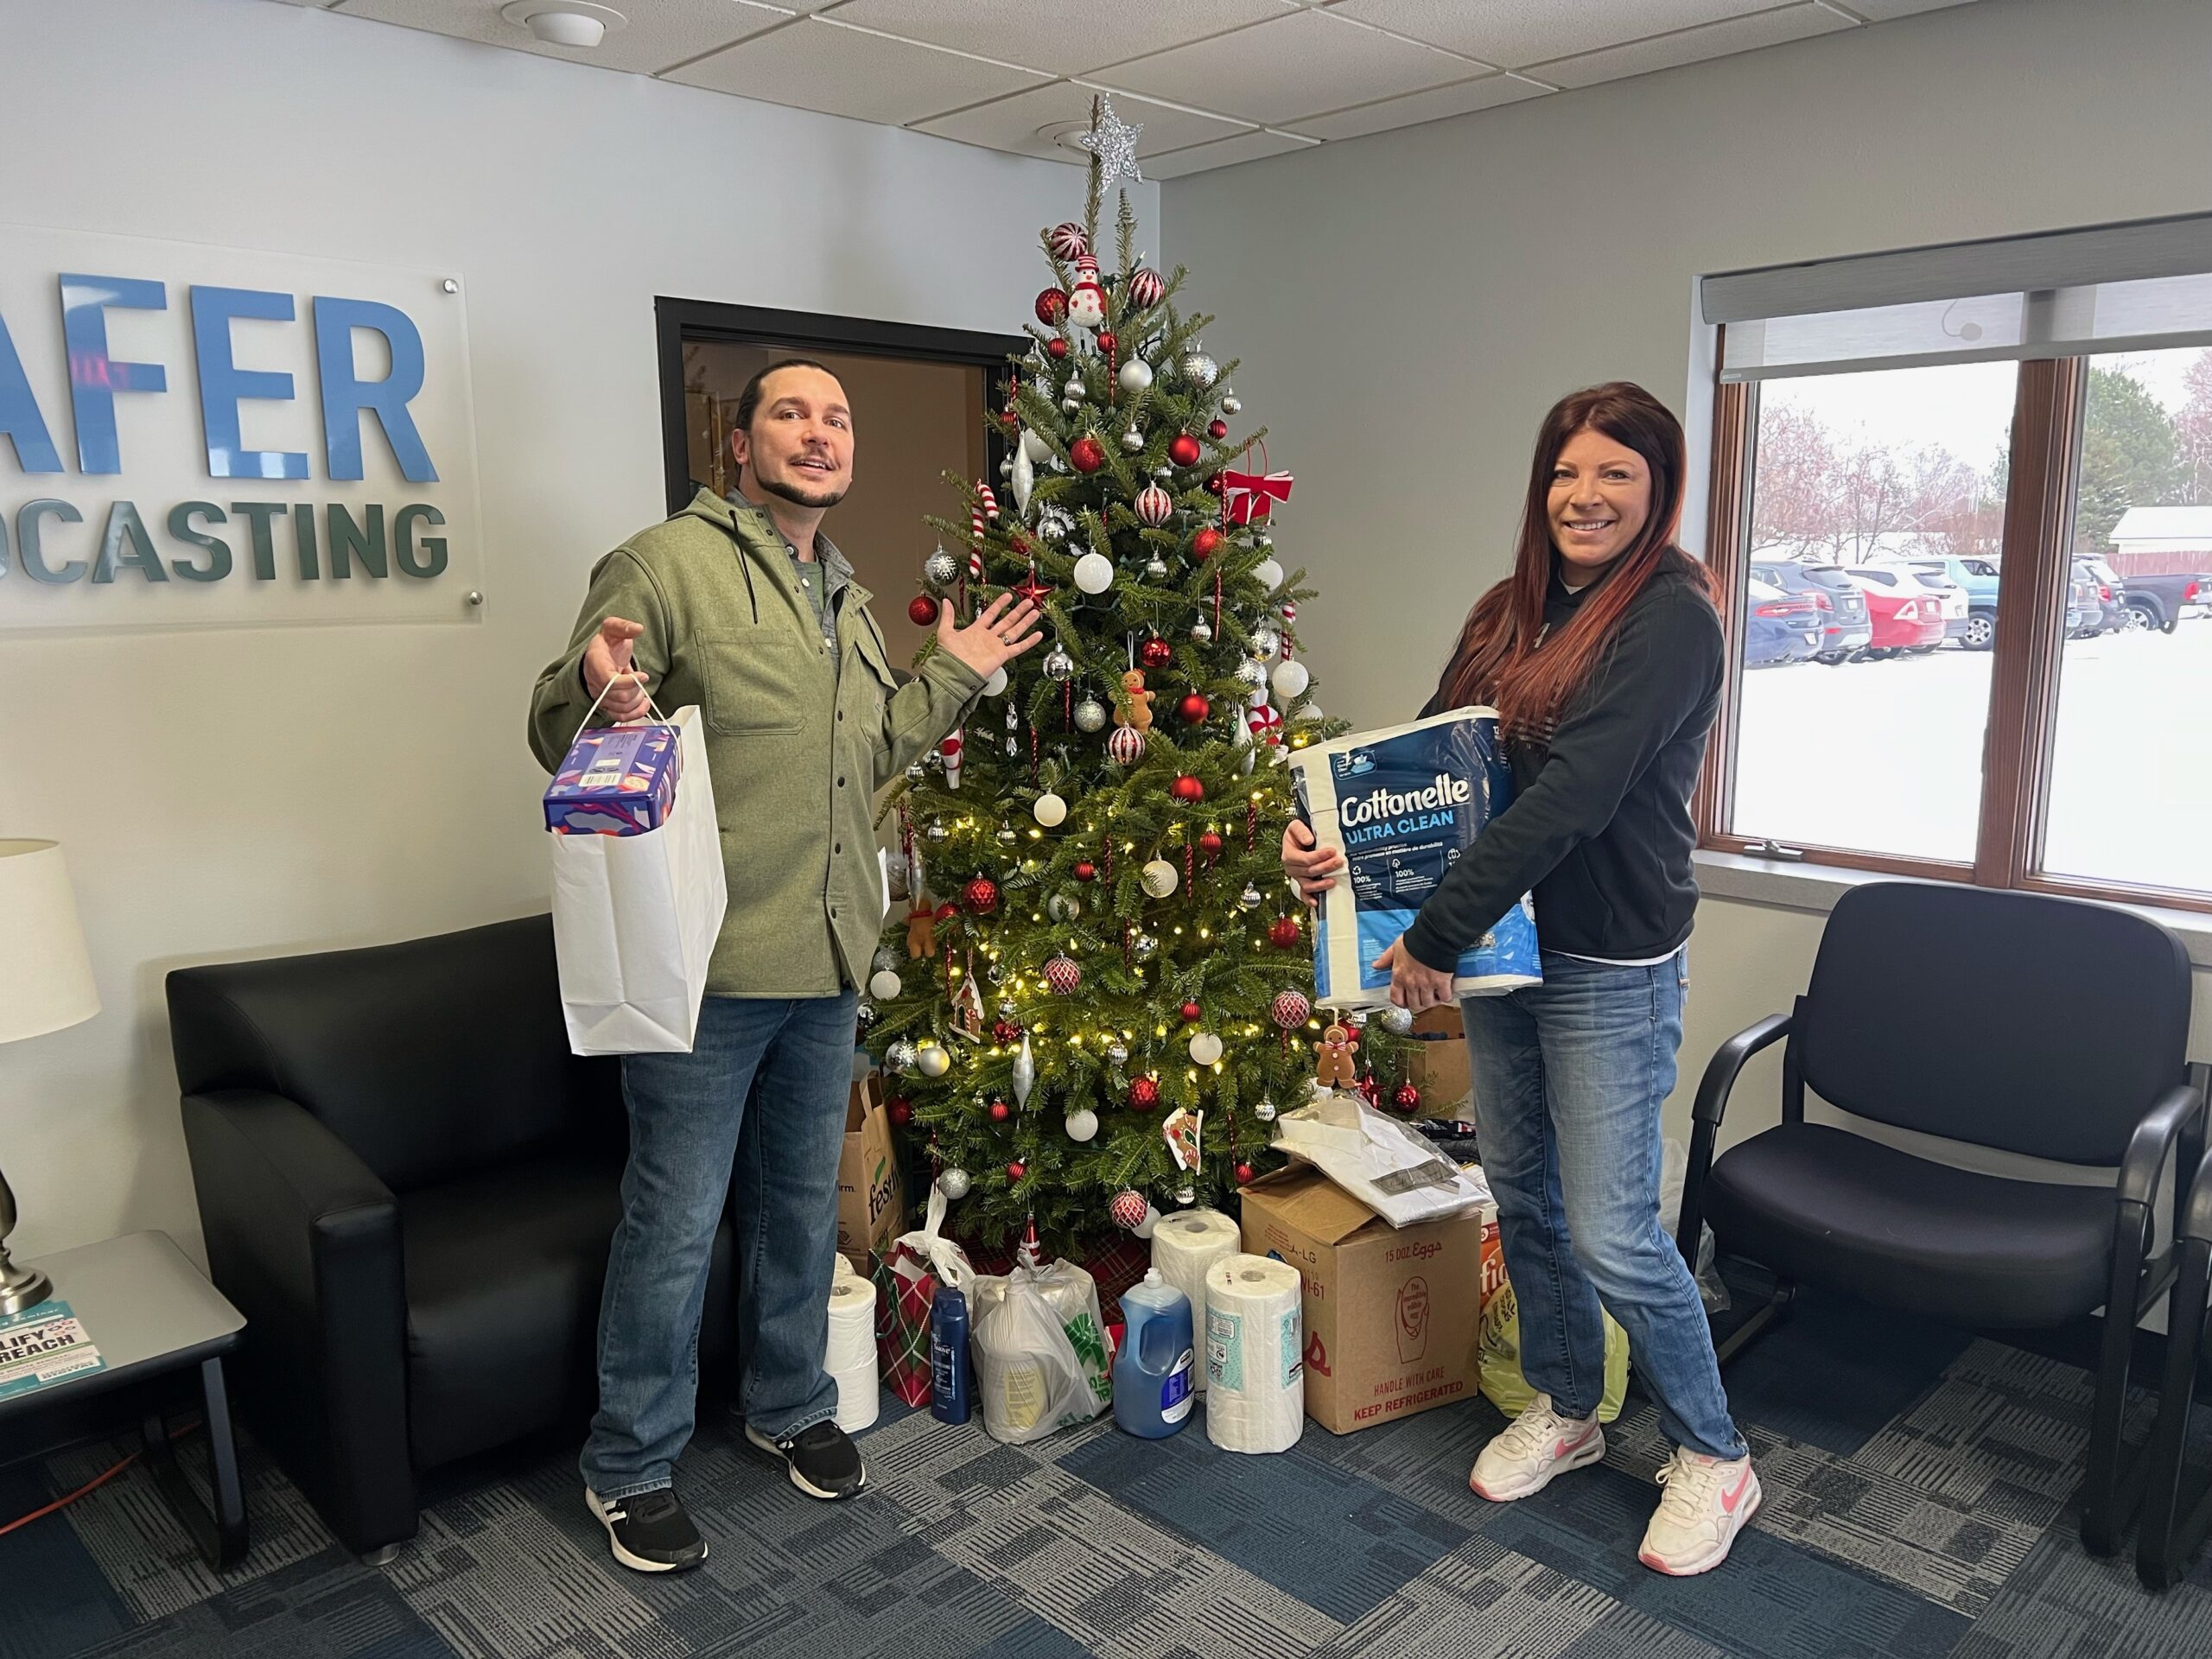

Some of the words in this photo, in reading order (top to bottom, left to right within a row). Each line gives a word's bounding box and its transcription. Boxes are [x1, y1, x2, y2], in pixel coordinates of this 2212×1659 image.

[0, 498, 449, 585] CASTING
[1341, 772, 1470, 827] Cottonelle
[1346, 823, 1395, 844] ULTRA
[1397, 810, 1454, 834] CLEAN
[1353, 875, 1372, 884] 100%
[1395, 868, 1415, 878] 100%
[1385, 1249, 1394, 1262] 15
[1396, 1246, 1411, 1261] DOZ
[1412, 1242, 1442, 1260] Eggs
[1374, 1377, 1403, 1396] HANDLE
[1406, 1373, 1424, 1388] WITH
[1426, 1366, 1445, 1382] CARE
[1354, 1403, 1382, 1421] KEEP
[1385, 1381, 1464, 1413] REFRIGERATED
